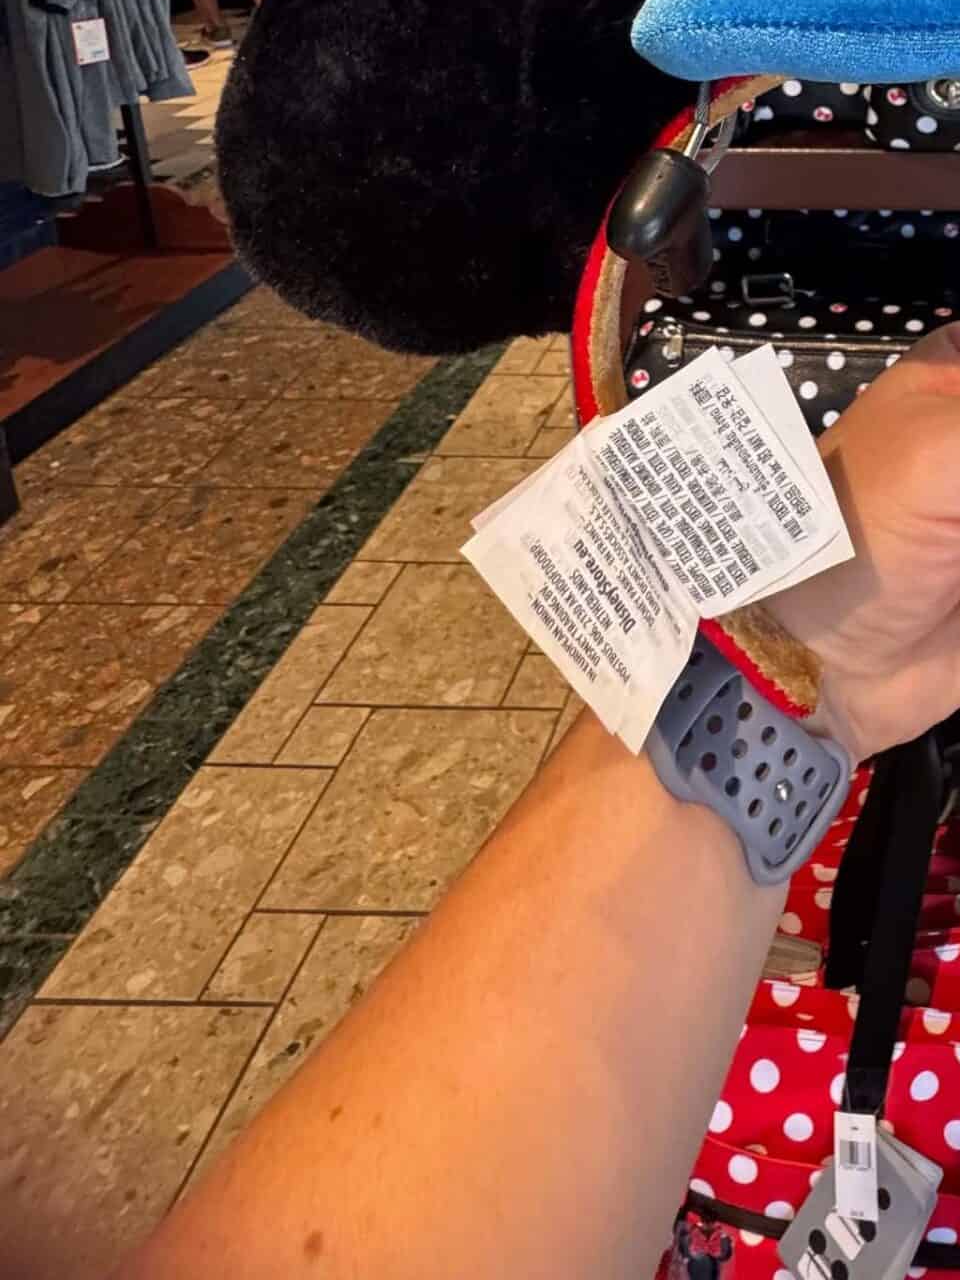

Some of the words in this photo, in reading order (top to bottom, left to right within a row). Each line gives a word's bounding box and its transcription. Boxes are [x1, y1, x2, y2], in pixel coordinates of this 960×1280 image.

[581, 519, 609, 554] FRANCE
[568, 538, 639, 634] DisneyStore.eu
[614, 569, 638, 599] PARKS
[624, 562, 649, 594] DISNEY
[528, 597, 558, 630] UNION
[546, 596, 581, 638] TRADING
[567, 568, 614, 631] NETHERLANDS
[642, 590, 662, 616] EURO
[549, 624, 591, 673] EUROPEAN
[573, 632, 603, 666] DISNEY
[598, 641, 633, 684] POSTBUS
